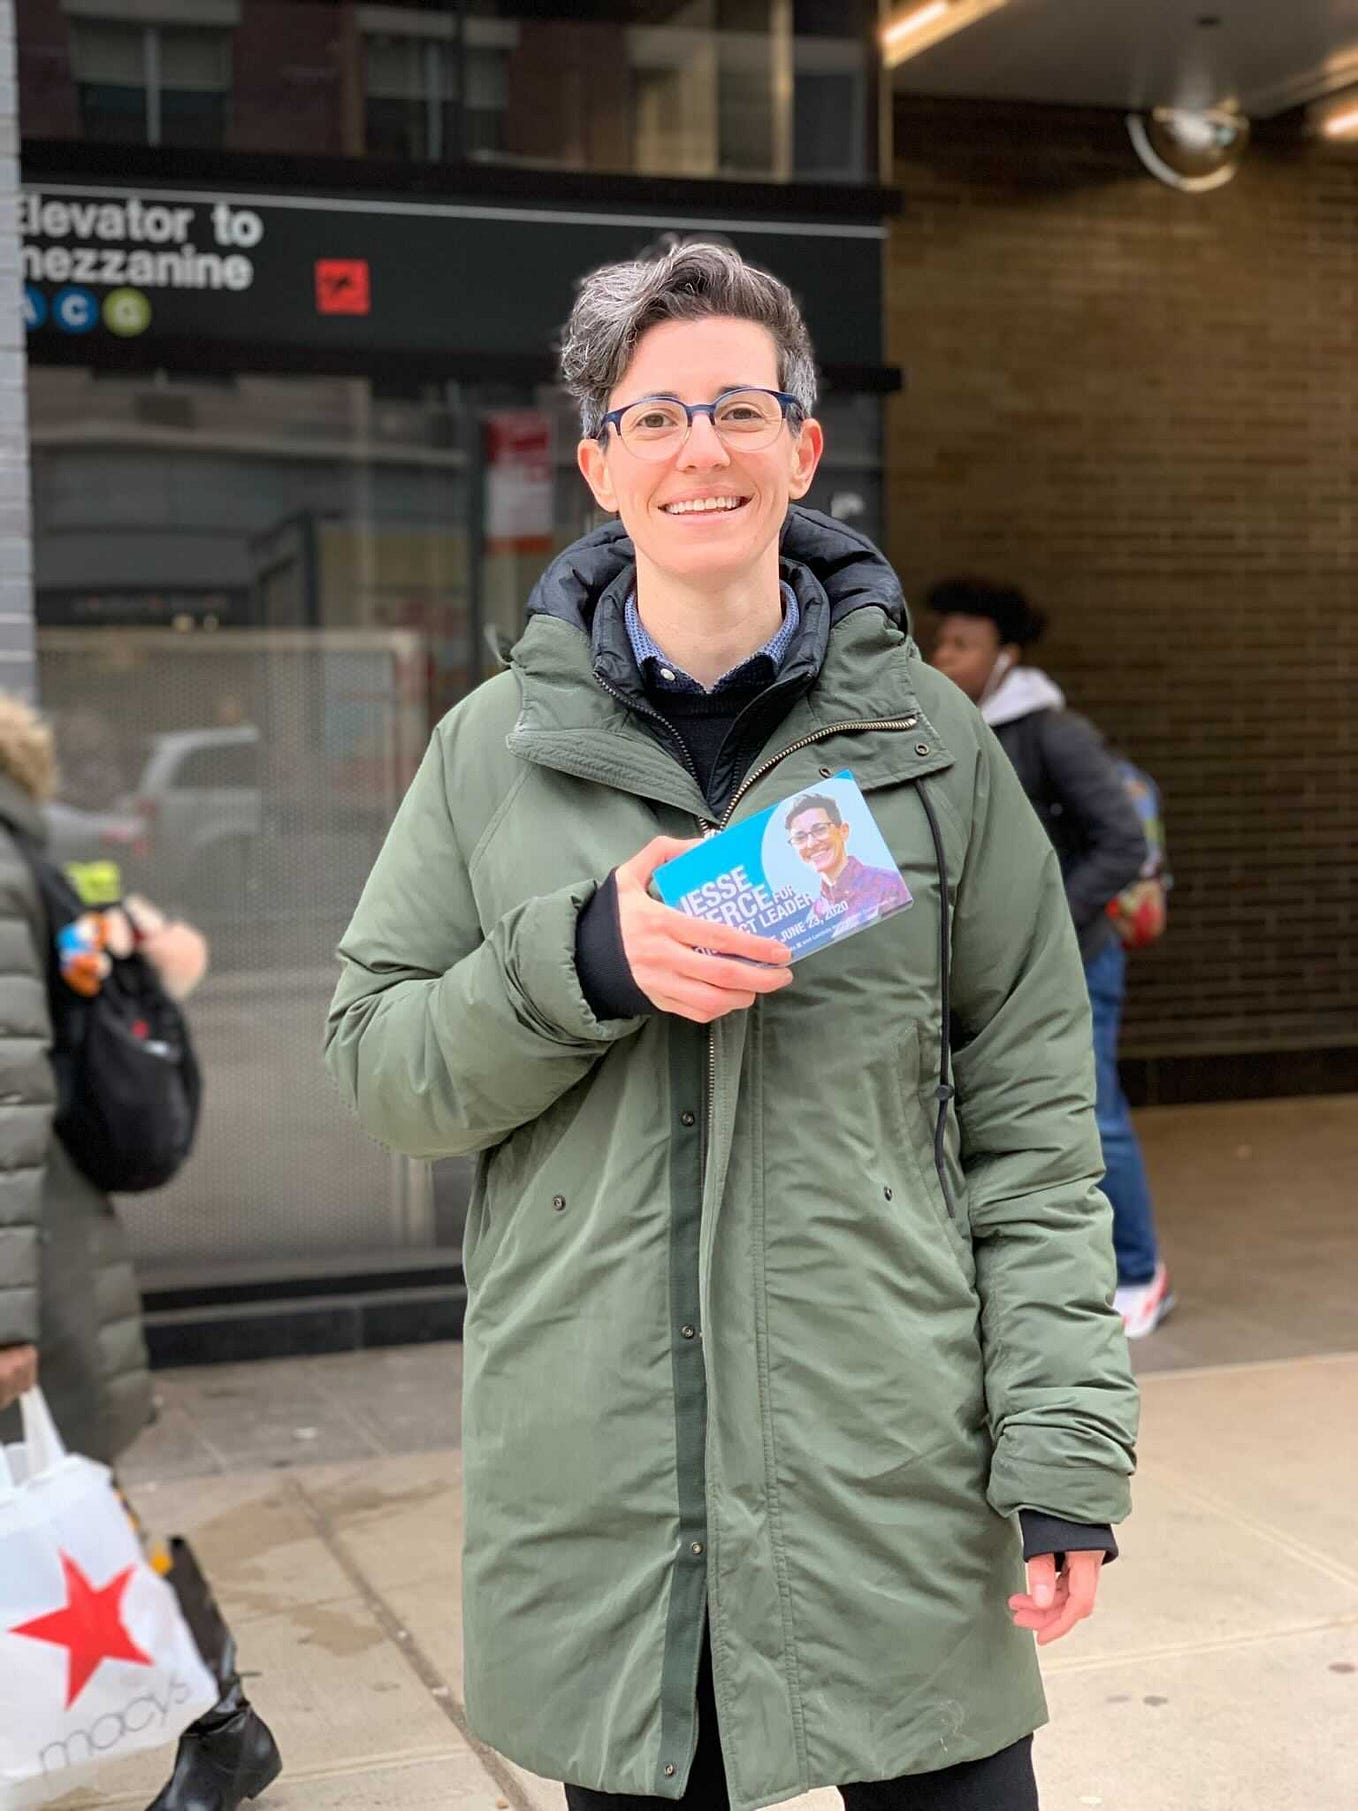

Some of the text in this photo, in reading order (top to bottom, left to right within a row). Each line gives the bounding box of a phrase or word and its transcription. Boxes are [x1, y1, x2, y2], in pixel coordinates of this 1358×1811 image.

[211, 202, 264, 248] to
[60, 294, 89, 326] C
[700, 884, 774, 928] ERCE
[759, 893, 816, 928] LEADER
[780, 921, 807, 943] JUNE
[824, 900, 849, 921] 2020
